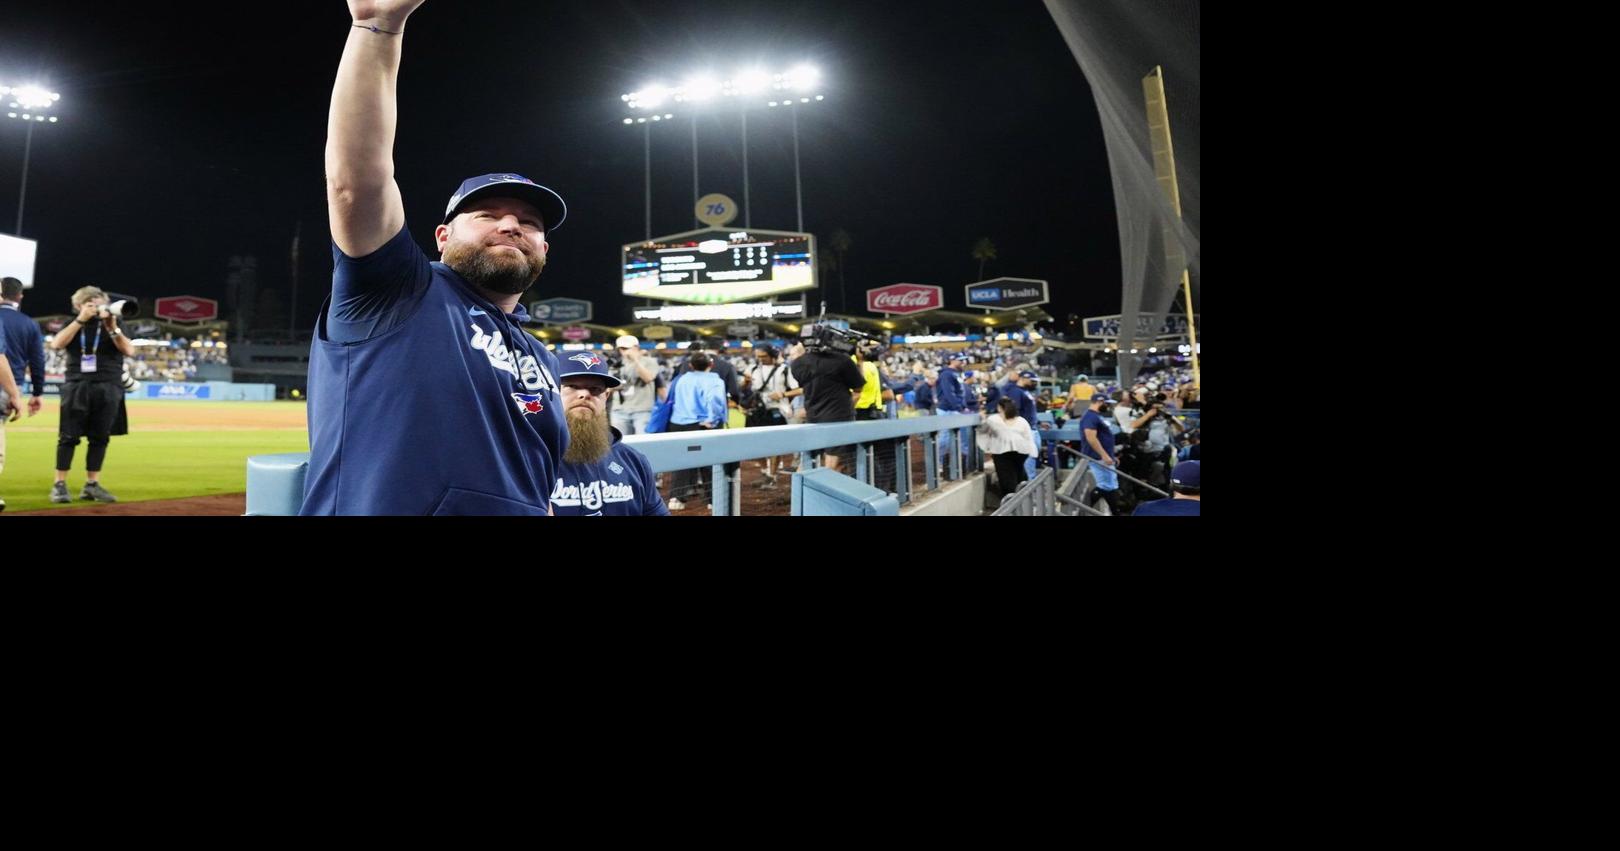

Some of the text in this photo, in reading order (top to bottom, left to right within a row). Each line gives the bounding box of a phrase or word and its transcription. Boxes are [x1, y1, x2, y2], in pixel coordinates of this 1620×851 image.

[705, 203, 724, 216] 76
[971, 286, 1040, 299] UCLA Health
